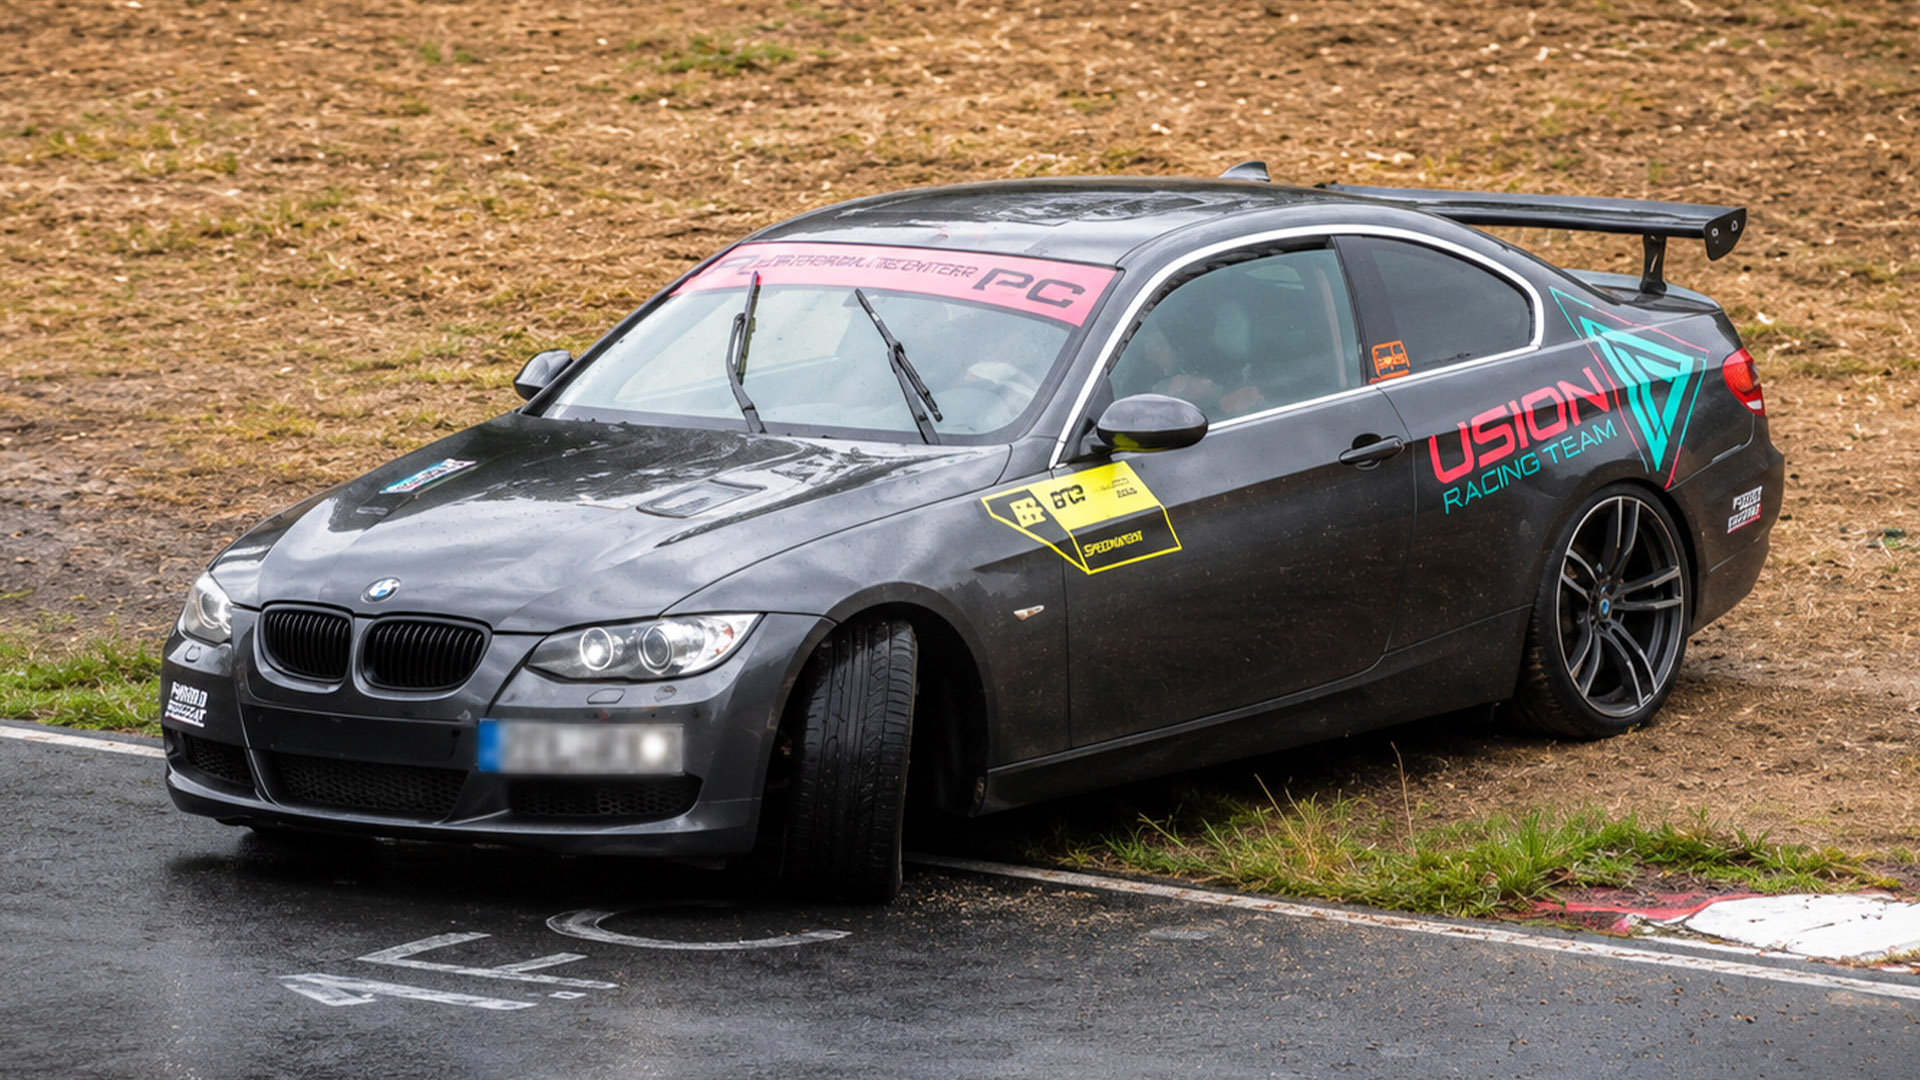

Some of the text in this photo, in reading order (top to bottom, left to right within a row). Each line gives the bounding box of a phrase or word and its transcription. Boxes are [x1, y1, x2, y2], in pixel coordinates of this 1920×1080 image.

[972, 267, 1086, 308] PC
[1428, 366, 1610, 484] USION
[1443, 419, 1617, 514] RACING TEAM
